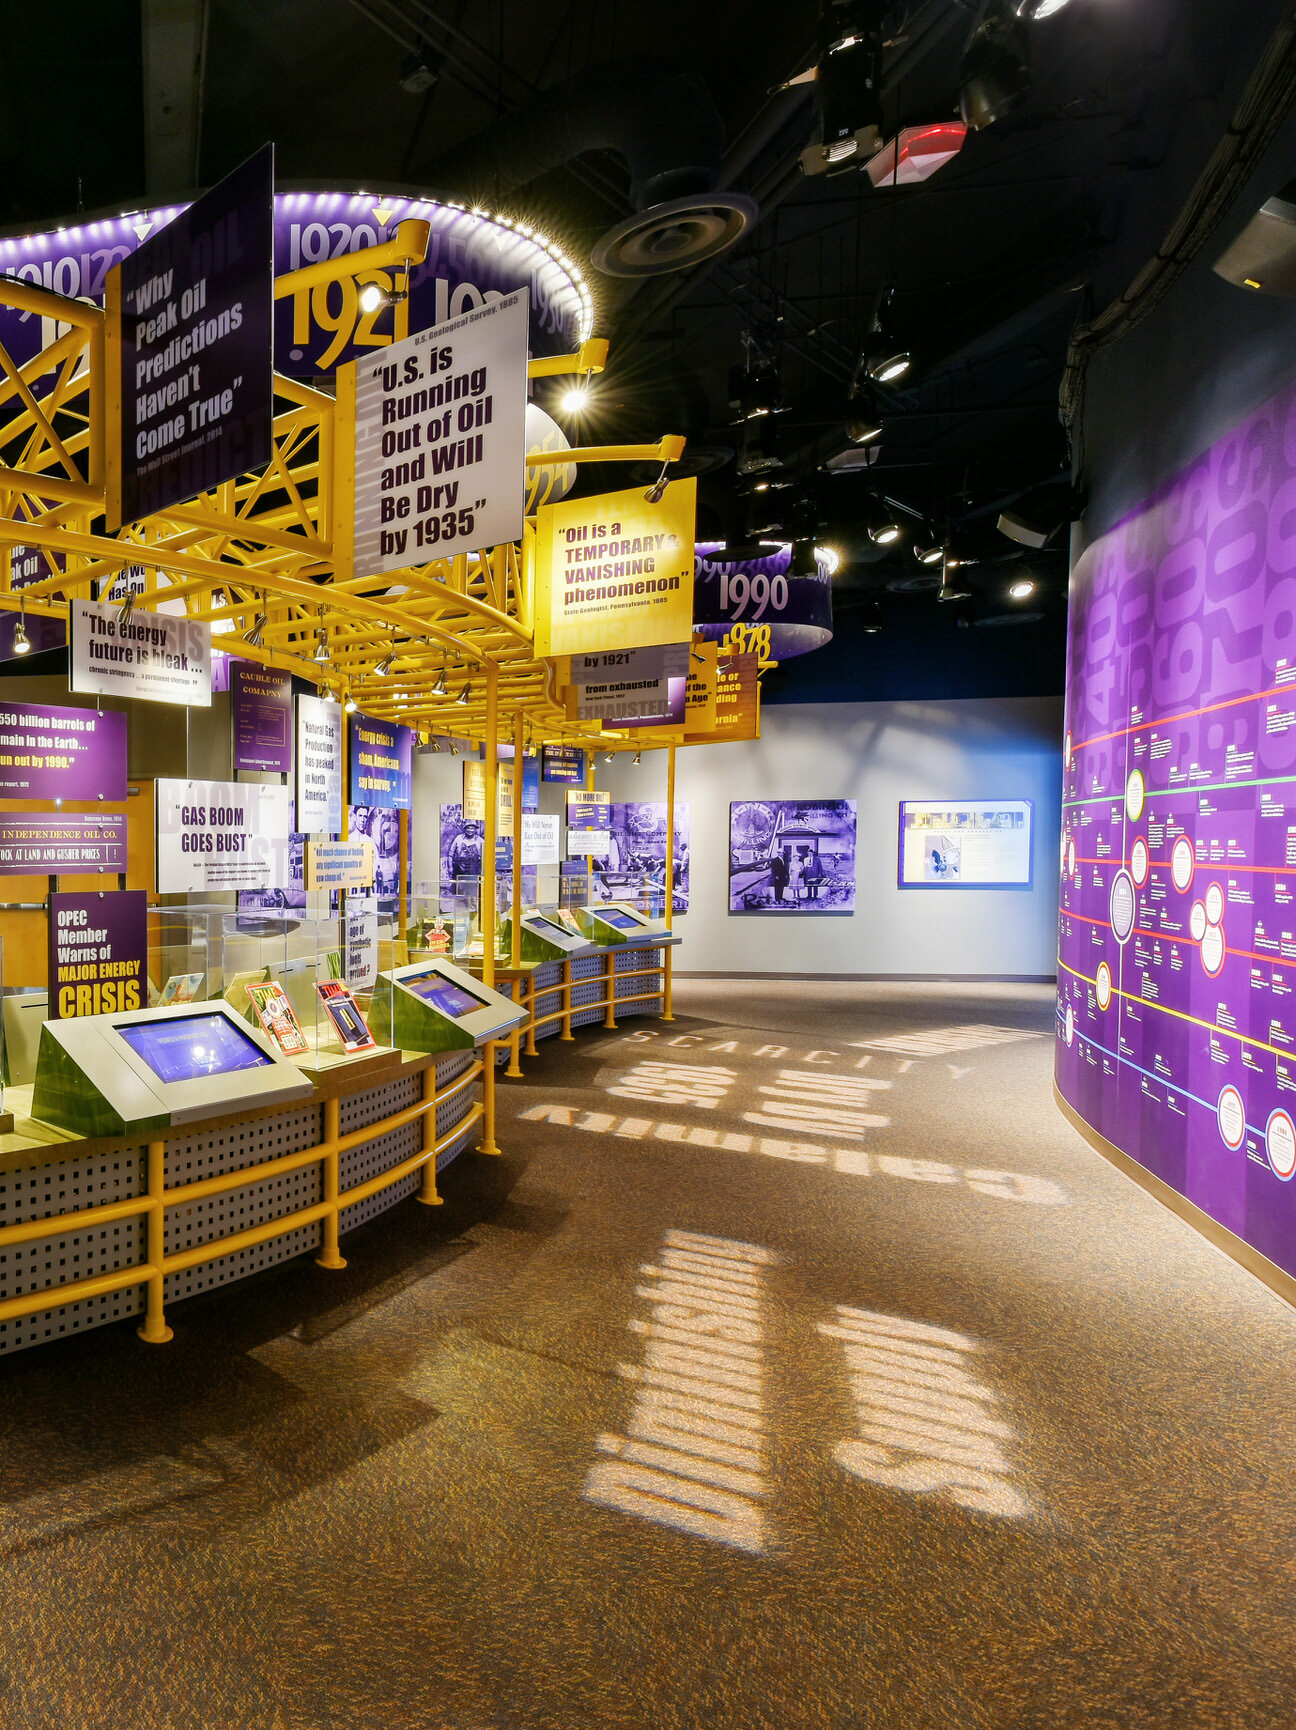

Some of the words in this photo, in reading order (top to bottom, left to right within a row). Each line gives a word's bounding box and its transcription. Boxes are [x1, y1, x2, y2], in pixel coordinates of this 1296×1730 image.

[136, 302, 178, 352] Peak
[181, 277, 207, 321] Oil
[415, 333, 427, 346] U.S.
[429, 317, 468, 340] Geological
[136, 302, 243, 390] Predictions
[430, 346, 453, 376] is
[383, 366, 487, 426] Running
[381, 422, 422, 458] Out
[427, 410, 452, 443] of
[458, 394, 492, 434] Oil
[136, 414, 185, 460] Come
[381, 453, 425, 491] and
[432, 434, 484, 476] Will
[380, 498, 410, 524] Be
[416, 481, 459, 514] Dry
[592, 524, 607, 539] is
[611, 522, 621, 536] a
[380, 528, 408, 557] by
[565, 533, 665, 564] TEMPORARY
[23, 555, 39, 577] Oil
[565, 557, 655, 585] VANISHING
[720, 573, 789, 621] 1990
[119, 622, 167, 647] energy
[89, 639, 133, 664] future
[136, 646, 149, 665] is
[152, 648, 189, 672] bleak
[584, 655, 600, 668] by
[89, 665, 109, 675] chronic
[109, 667, 135, 679] stringency
[272, 677, 285, 686] OIL
[728, 672, 738, 681] or
[585, 684, 607, 694] from
[19, 714, 50, 729] billion
[51, 717, 85, 732] barrels
[86, 720, 95, 732] of
[325, 724, 334, 738] Gas
[26, 735, 36, 747] in
[37, 736, 53, 748] the
[305, 738, 333, 753] Production
[14, 755, 31, 767] out
[32, 755, 44, 768] by
[305, 756, 315, 768] has
[316, 757, 334, 770] peaked
[374, 753, 400, 771] Americans
[305, 773, 311, 782] in
[311, 774, 326, 785] North
[209, 807, 244, 826] BOOM
[2, 830, 82, 839] INDEPENDENCE
[83, 830, 100, 839] OIL
[181, 833, 213, 853] GOES
[15, 849, 23, 861] AT
[24, 849, 41, 861] LAND
[42, 848, 57, 861] AND
[57, 848, 80, 860] GUSHER
[81, 848, 101, 860] PRICES
[57, 909, 88, 927] OPEC
[57, 927, 107, 946] Member
[349, 926, 359, 938] age
[57, 947, 98, 964] Warns
[100, 944, 111, 960] of
[57, 964, 98, 983] MAJOR
[99, 960, 141, 979] ENERGY
[58, 979, 141, 1020] CRISIS
[254, 986, 278, 1001] TIME
[620, 1029, 977, 1081] SCARCITY
[515, 1103, 1070, 1205] Calamity
